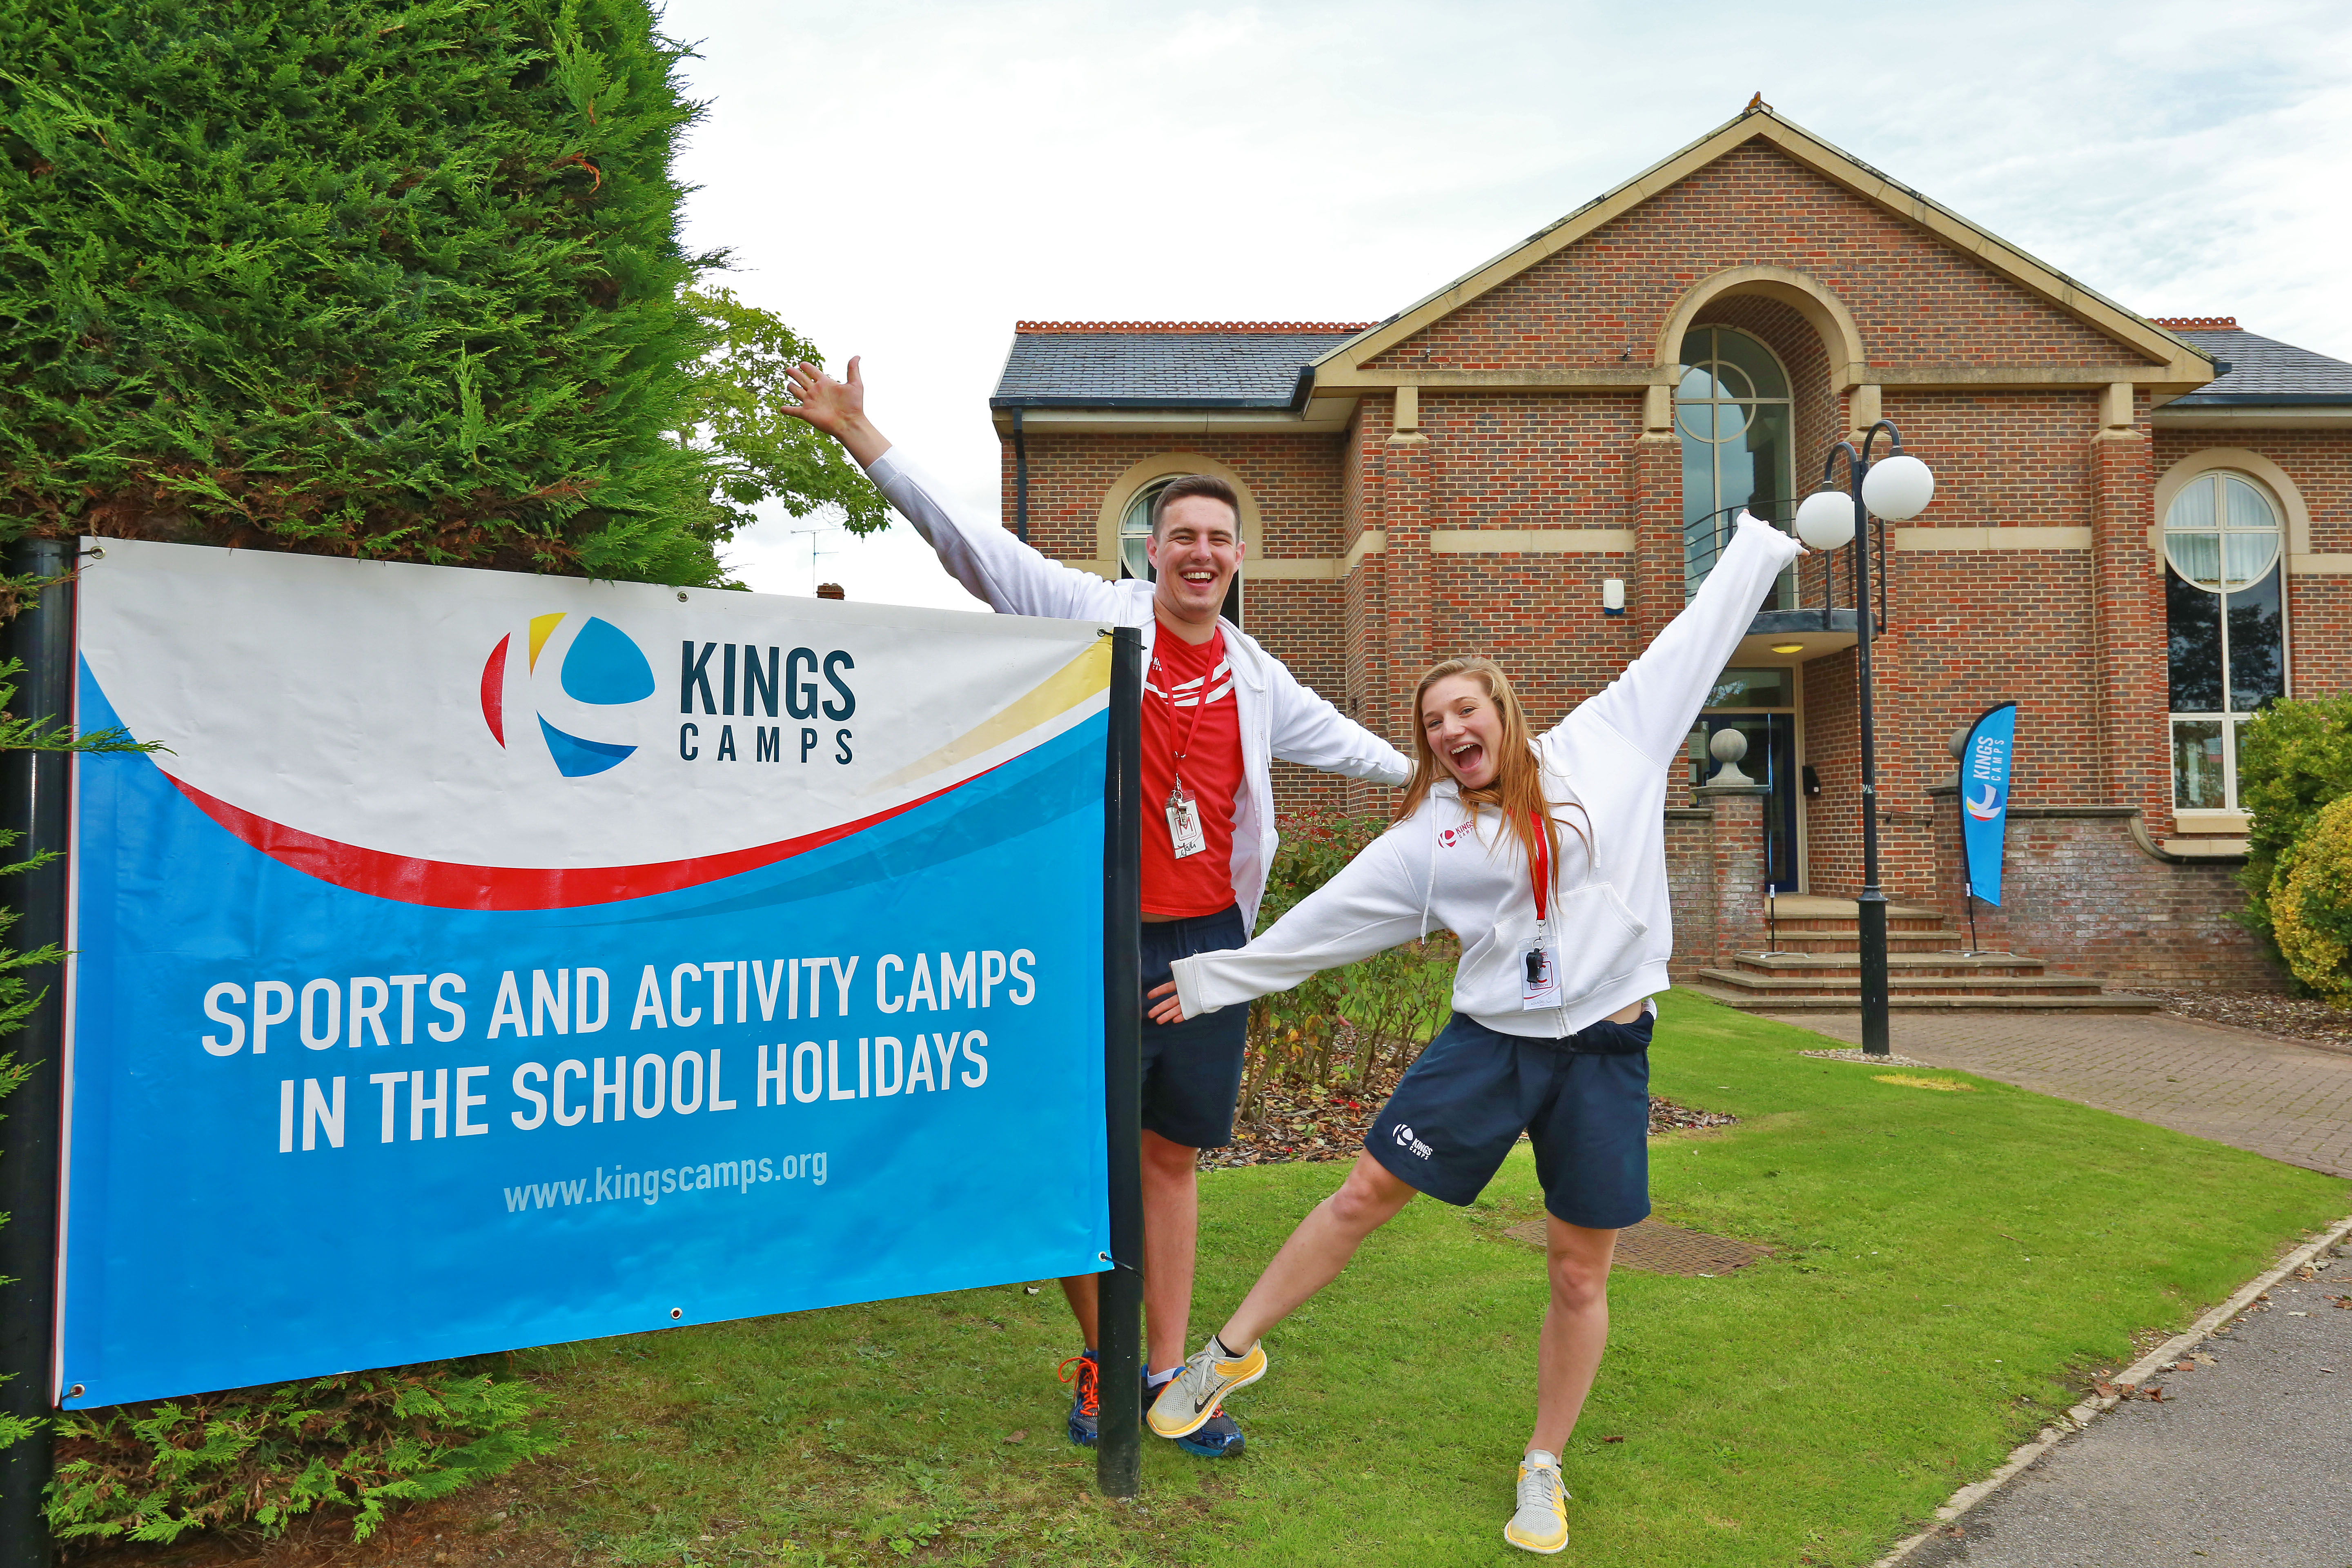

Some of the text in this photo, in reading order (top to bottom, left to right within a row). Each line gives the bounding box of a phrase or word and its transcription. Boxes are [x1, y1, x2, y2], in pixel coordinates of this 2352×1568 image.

[680, 640, 856, 722] KINGS
[680, 722, 853, 765] CAMPS
[1973, 736, 1993, 780] KINGS
[1991, 740, 2004, 781] CAMPS
[1459, 828, 1473, 838] CAMP
[202, 949, 1036, 1056] SPORTS AND ACTIVITY CAMPS
[280, 1030, 988, 1153] IN THE SCHOOL HOLIDAYS
[1409, 1146, 1429, 1160] CAMPS
[1412, 1138, 1433, 1156] KINGS
[504, 1152, 827, 1213] www.kingscamps.org
